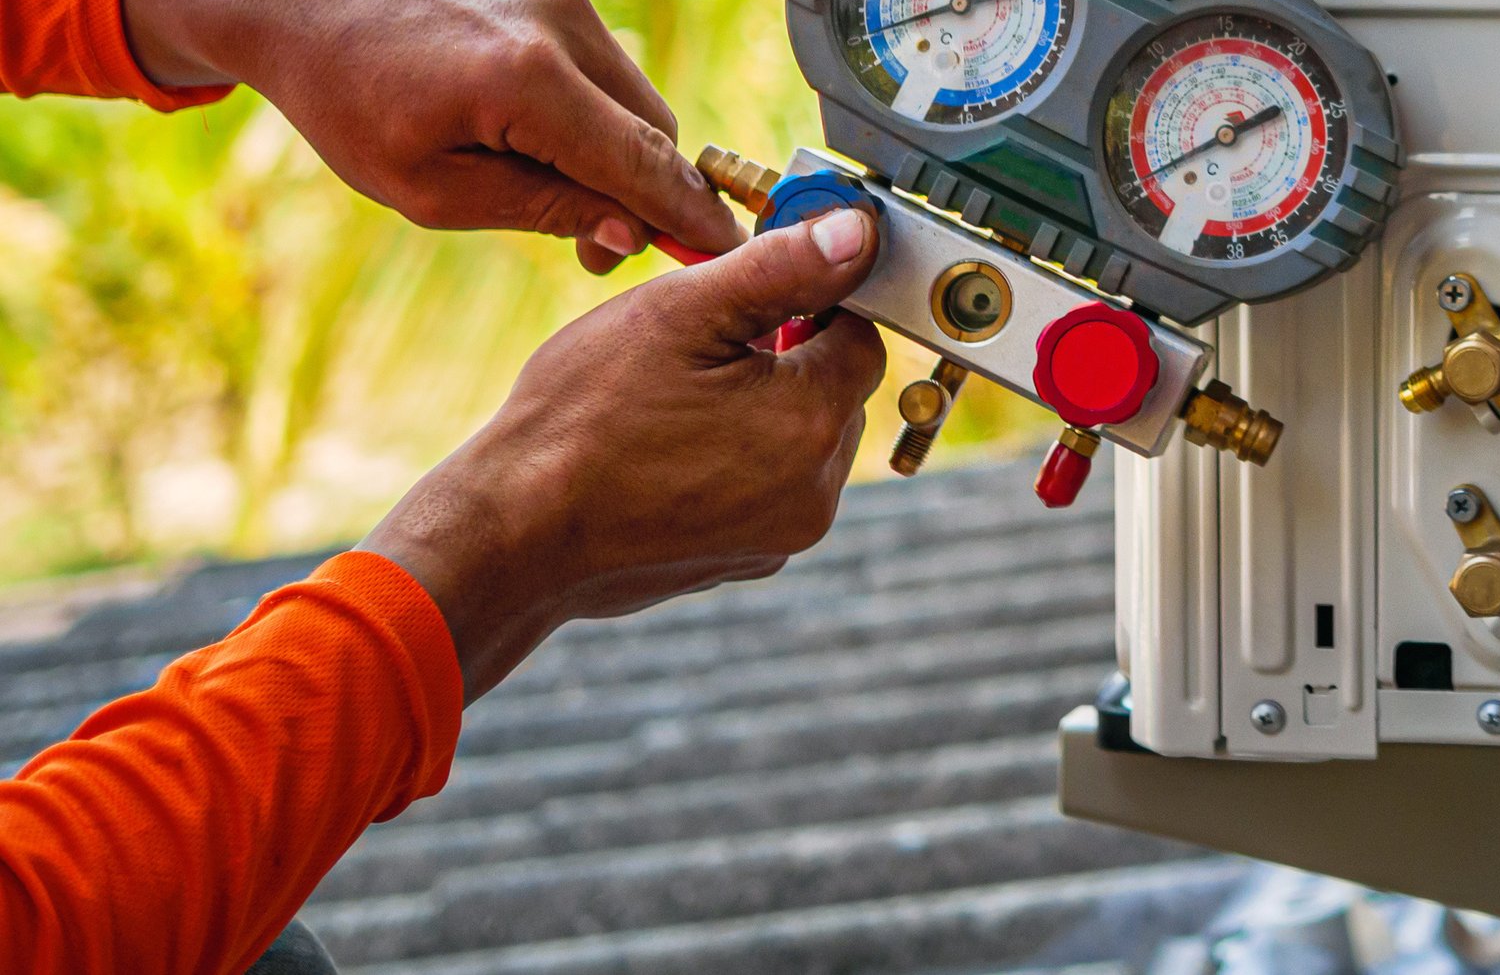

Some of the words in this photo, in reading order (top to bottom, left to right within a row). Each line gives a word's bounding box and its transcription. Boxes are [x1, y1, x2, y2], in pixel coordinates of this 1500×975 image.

[1217, 16, 1234, 31] 15
[847, 35, 861, 46] 0
[1038, 28, 1050, 46] 200
[1147, 41, 1165, 59] 10
[1287, 36, 1307, 56] 20
[964, 68, 980, 78] R22
[964, 78, 990, 89] R134a
[1184, 76, 1197, 87] +30
[975, 87, 992, 98] 250
[1144, 90, 1156, 106] 100
[1167, 93, 1178, 106] +20
[1304, 97, 1317, 114] 350
[1329, 99, 1347, 119] 25
[958, 112, 975, 125] 18
[1311, 137, 1320, 155] 400
[1322, 174, 1340, 194] 30
[1264, 206, 1282, 220] 500
[1226, 221, 1244, 232] 550
[1269, 229, 1289, 249] 35
[1226, 244, 1245, 260] 38
